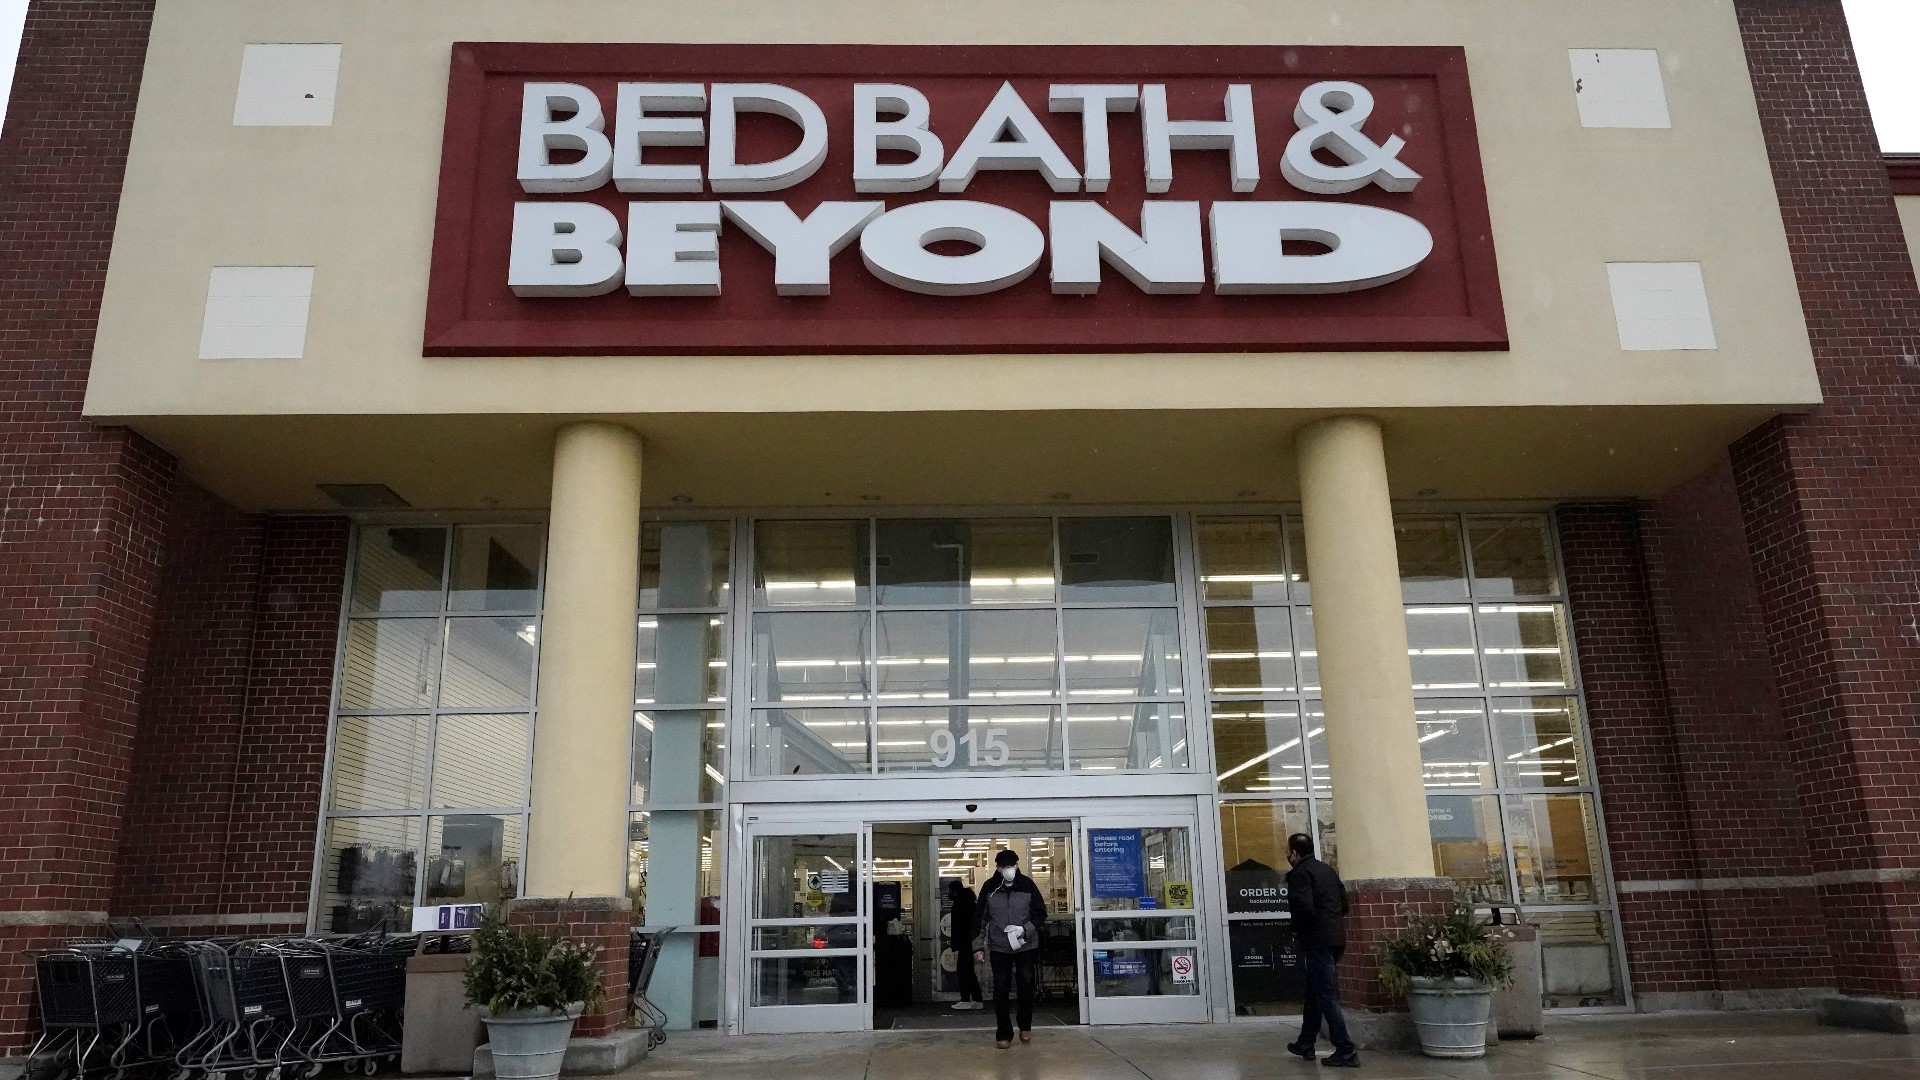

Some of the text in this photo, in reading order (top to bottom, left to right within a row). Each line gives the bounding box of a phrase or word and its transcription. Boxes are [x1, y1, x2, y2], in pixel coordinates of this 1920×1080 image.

[516, 80, 1423, 194] BED BATH &
[507, 200, 1434, 297] BEYOND
[929, 728, 1010, 768] 915
[1240, 888, 1277, 897] ORDER
